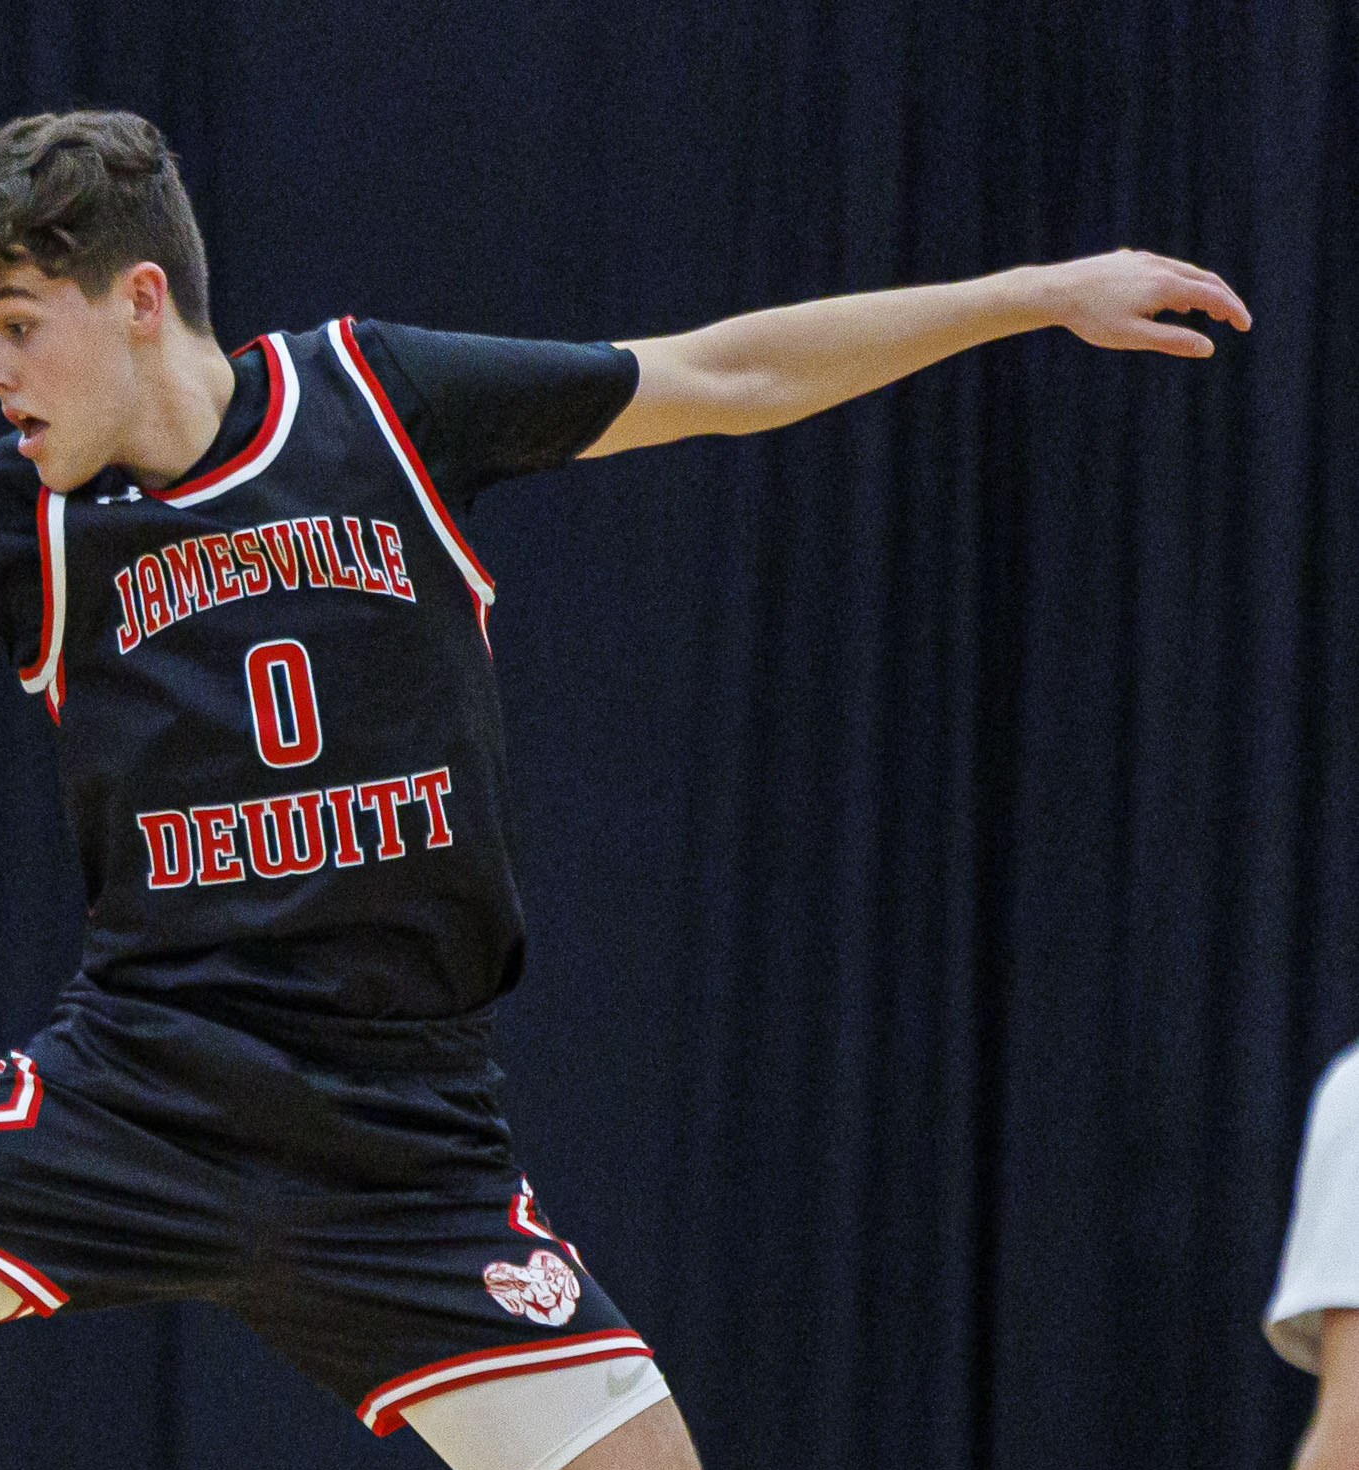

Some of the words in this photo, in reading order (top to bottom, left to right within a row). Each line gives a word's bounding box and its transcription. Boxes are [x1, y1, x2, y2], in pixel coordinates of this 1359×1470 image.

[114, 515, 416, 655] JAMESVILLE
[244, 637, 323, 769] 0
[136, 766, 453, 890] DEWITT
